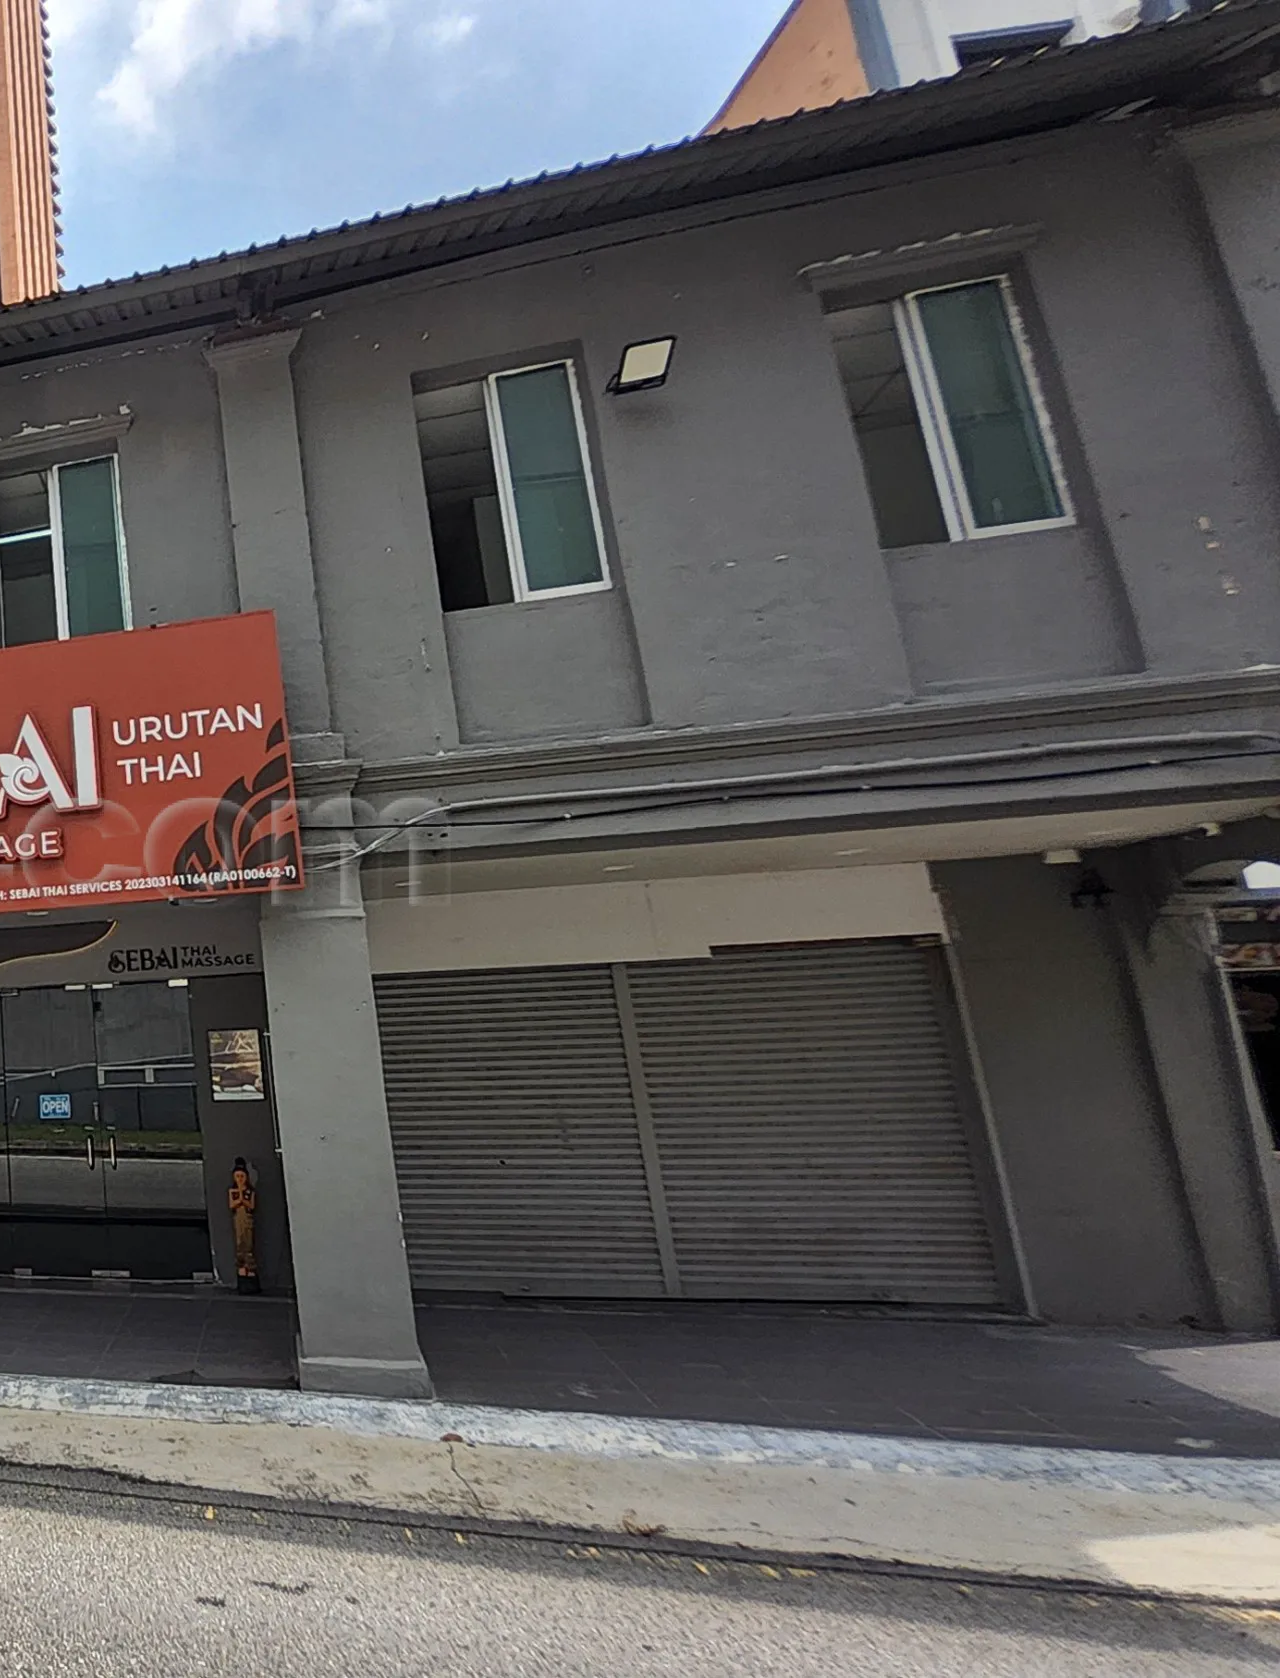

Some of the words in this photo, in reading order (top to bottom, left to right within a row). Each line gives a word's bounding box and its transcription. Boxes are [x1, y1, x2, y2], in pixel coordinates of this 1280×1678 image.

[112, 703, 262, 745] URUTAN
[117, 752, 202, 784] THAI
[9, 888, 40, 900] SEBAI
[42, 885, 68, 897] THAI
[70, 879, 122, 895] SERVICES
[108, 947, 179, 974] SEBAI
[181, 945, 217, 957] THAI
[181, 953, 255, 968] MASSAGE
[42, 1100, 68, 1113] OPEN
